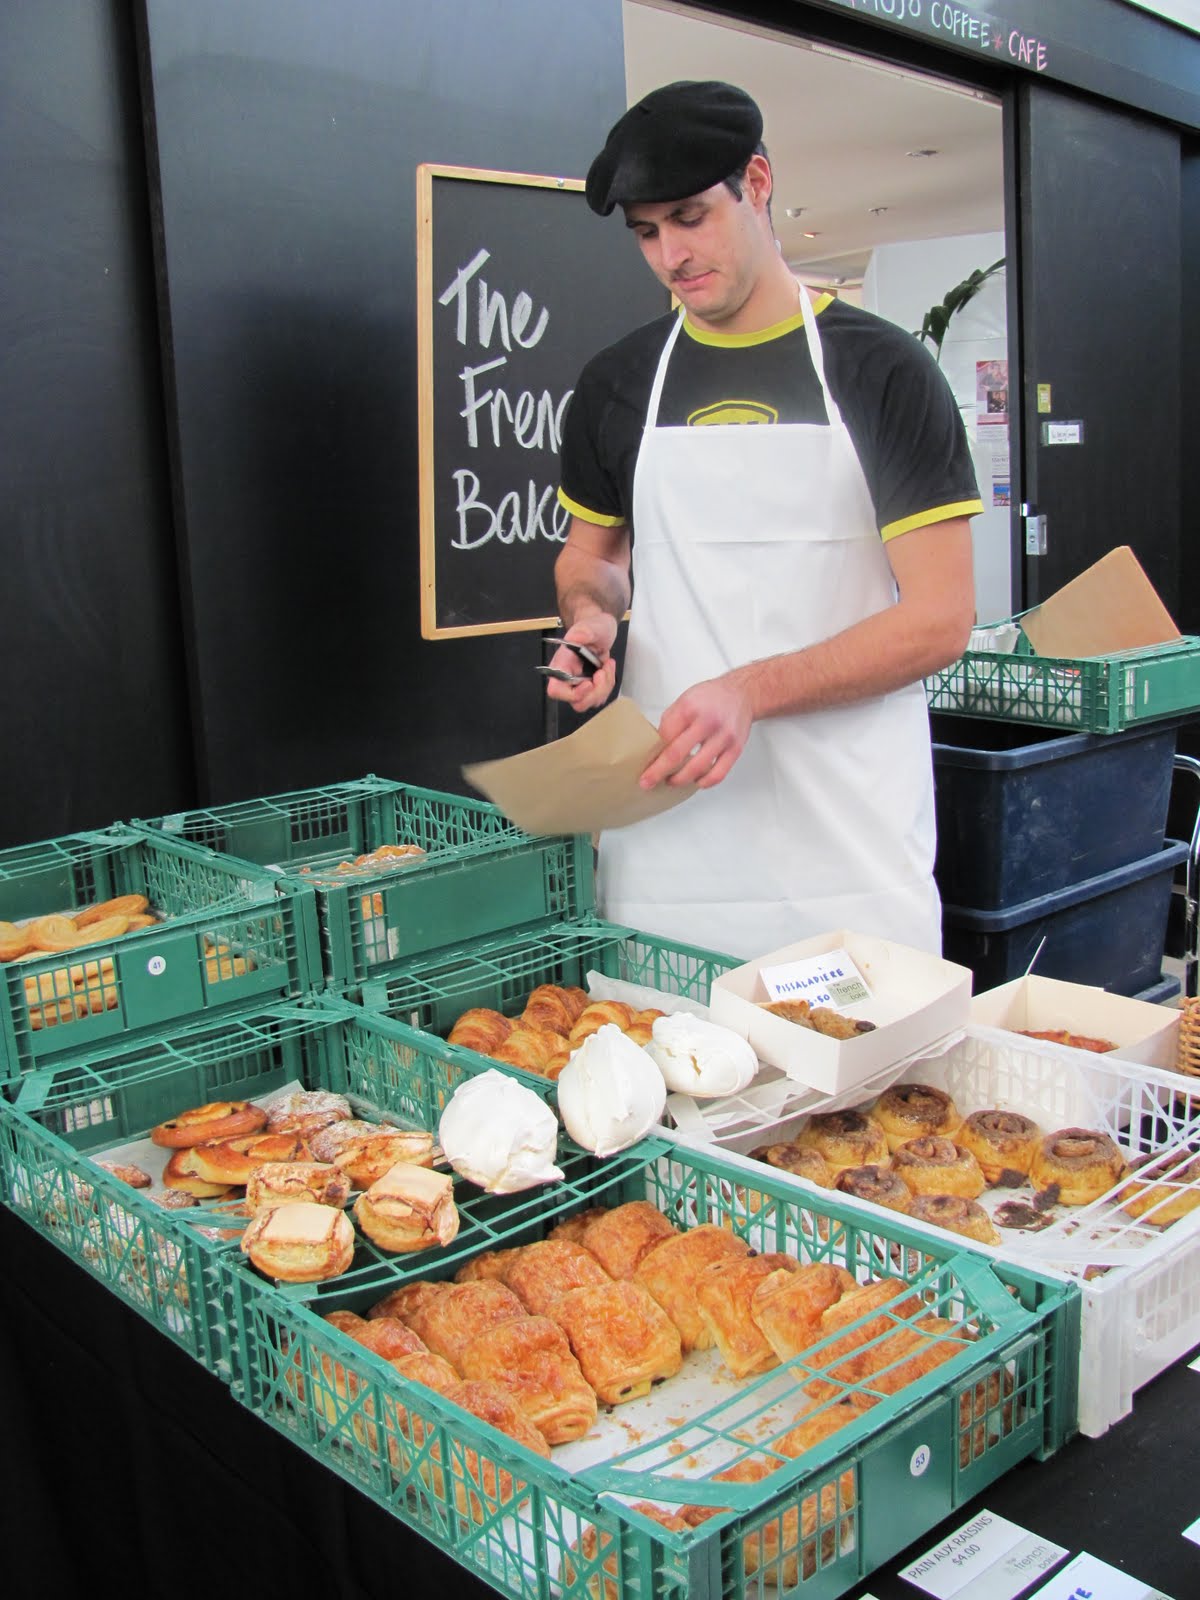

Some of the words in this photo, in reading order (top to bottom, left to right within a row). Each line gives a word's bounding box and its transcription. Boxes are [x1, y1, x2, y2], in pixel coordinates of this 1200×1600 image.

[862, 0, 922, 19] OJO
[931, 2, 990, 48] COFFEE
[1008, 30, 1048, 71] CAFE
[438, 248, 549, 352] The
[459, 356, 575, 454] Frenc
[451, 469, 571, 550] Bake
[915, 1452, 925, 1468] 53
[908, 1558, 936, 1579] PAIN
[936, 1543, 955, 1562] AUX
[952, 1515, 993, 1546] RAISINS
[952, 1543, 981, 1566] $4.00
[1013, 1544, 1047, 1571] french
